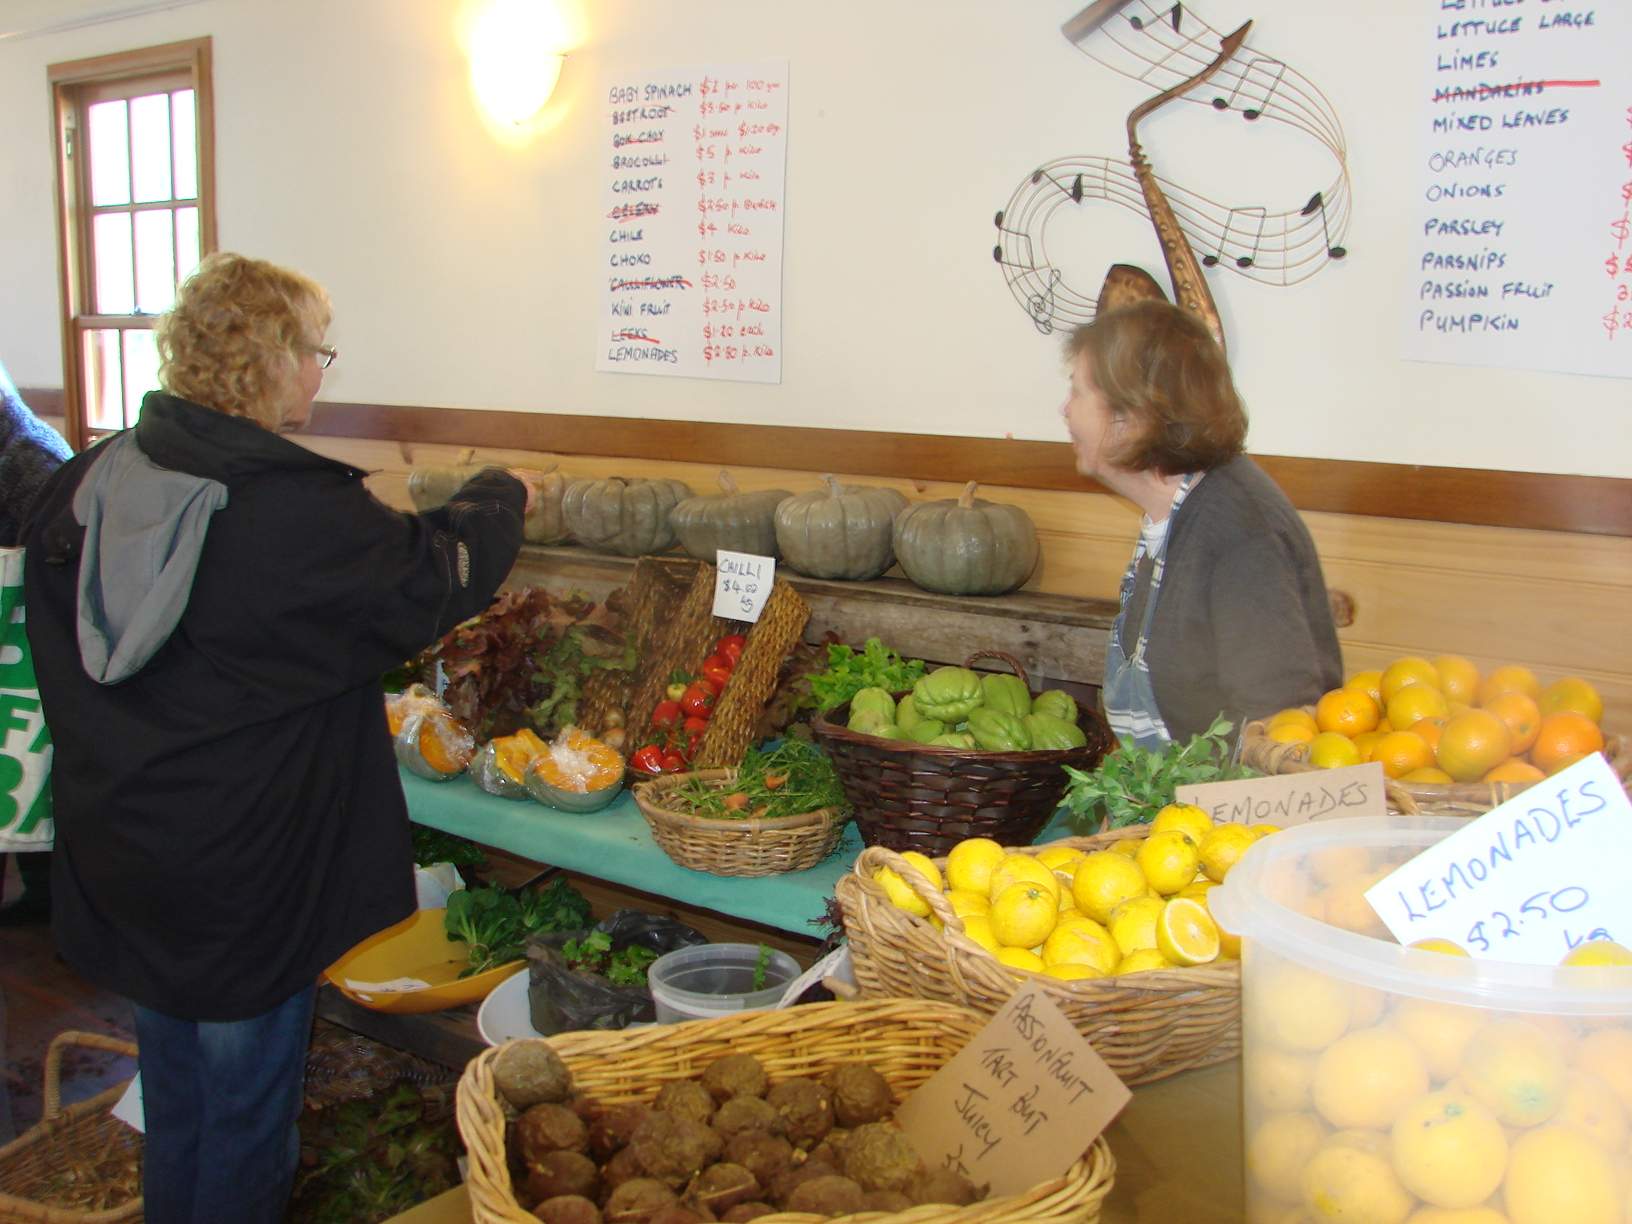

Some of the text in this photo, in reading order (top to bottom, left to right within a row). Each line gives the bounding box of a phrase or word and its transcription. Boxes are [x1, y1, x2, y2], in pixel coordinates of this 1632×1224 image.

[1437, 11, 1595, 39] LETTUCE LARGE
[609, 86, 639, 104] BABY
[644, 82, 693, 101] SPINACH
[1502, 108, 1570, 128] LEAVES
[1428, 147, 1519, 173] ORANGES
[612, 177, 663, 194] CARROTS
[1426, 183, 1506, 202] ONIONS
[1424, 217, 1504, 236] PARSLEY
[610, 252, 652, 267] CHOKO
[1421, 248, 1507, 271] PARSNIPS
[1420, 279, 1489, 300] PASSION
[1420, 309, 1520, 333] PUMPKIN
[608, 346, 679, 363] LEMONADES
[1398, 780, 1607, 922] LEMONADES
